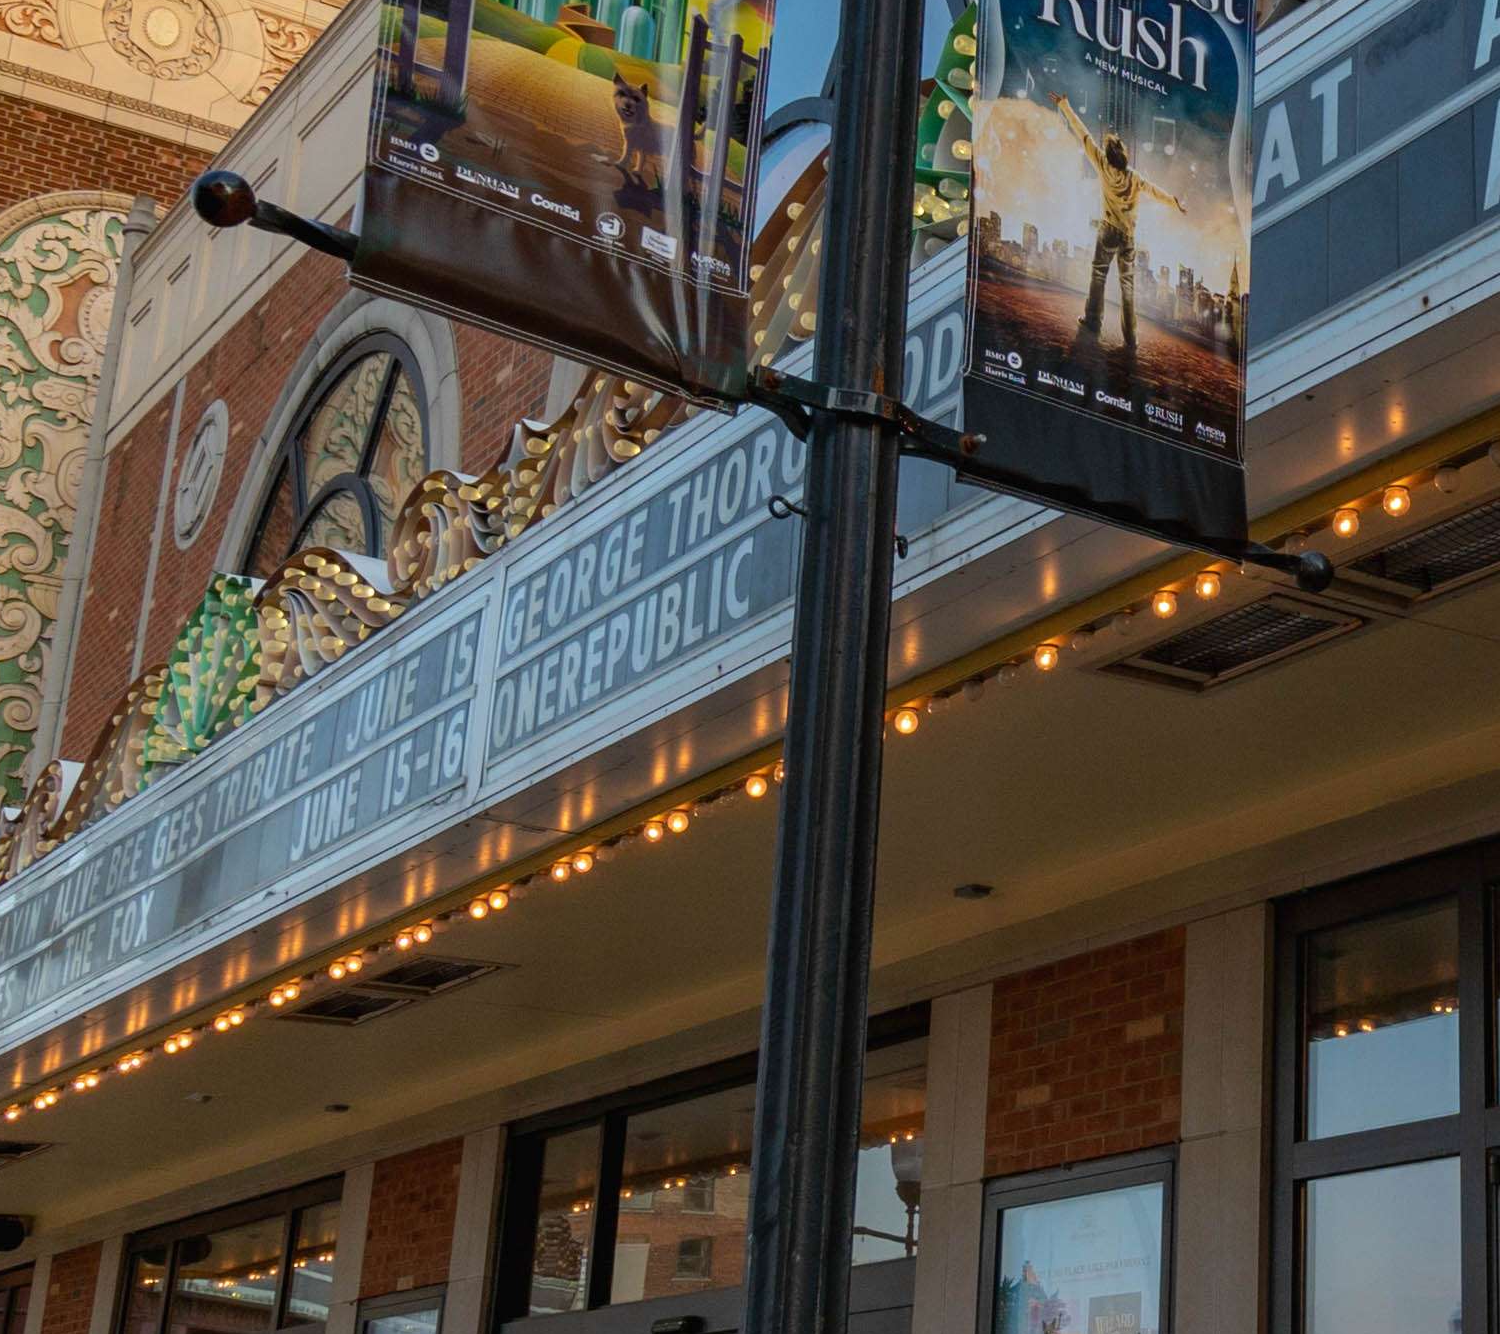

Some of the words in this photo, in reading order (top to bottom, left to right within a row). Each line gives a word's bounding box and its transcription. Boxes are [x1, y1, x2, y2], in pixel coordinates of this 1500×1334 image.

[1085, 52, 1093, 63] A
[1095, 58, 1118, 75] NEW
[1121, 69, 1169, 95] MUSICAL
[390, 136, 417, 152] BMO
[388, 155, 419, 171] Harris
[420, 165, 444, 182] Bank
[456, 166, 520, 194] DUNHAM
[530, 193, 581, 223] ComEd
[985, 350, 1005, 362] BMO
[985, 366, 1008, 379] Harris
[1095, 391, 1132, 412] ComEd
[1155, 407, 1182, 426] RUSH
[504, 508, 649, 655] GEORGE
[492, 536, 754, 749] ONEREPUBLIC
[51, 858, 104, 932] ALIVE
[106, 830, 146, 897] BEE
[152, 785, 208, 869] GEES
[213, 722, 316, 834] TRIBUTE
[346, 654, 422, 752] JUNE
[441, 619, 476, 696] 15
[62, 922, 96, 986] THE
[108, 889, 156, 960] FOX
[290, 767, 362, 862] JUNE
[381, 709, 467, 814] 15-16
